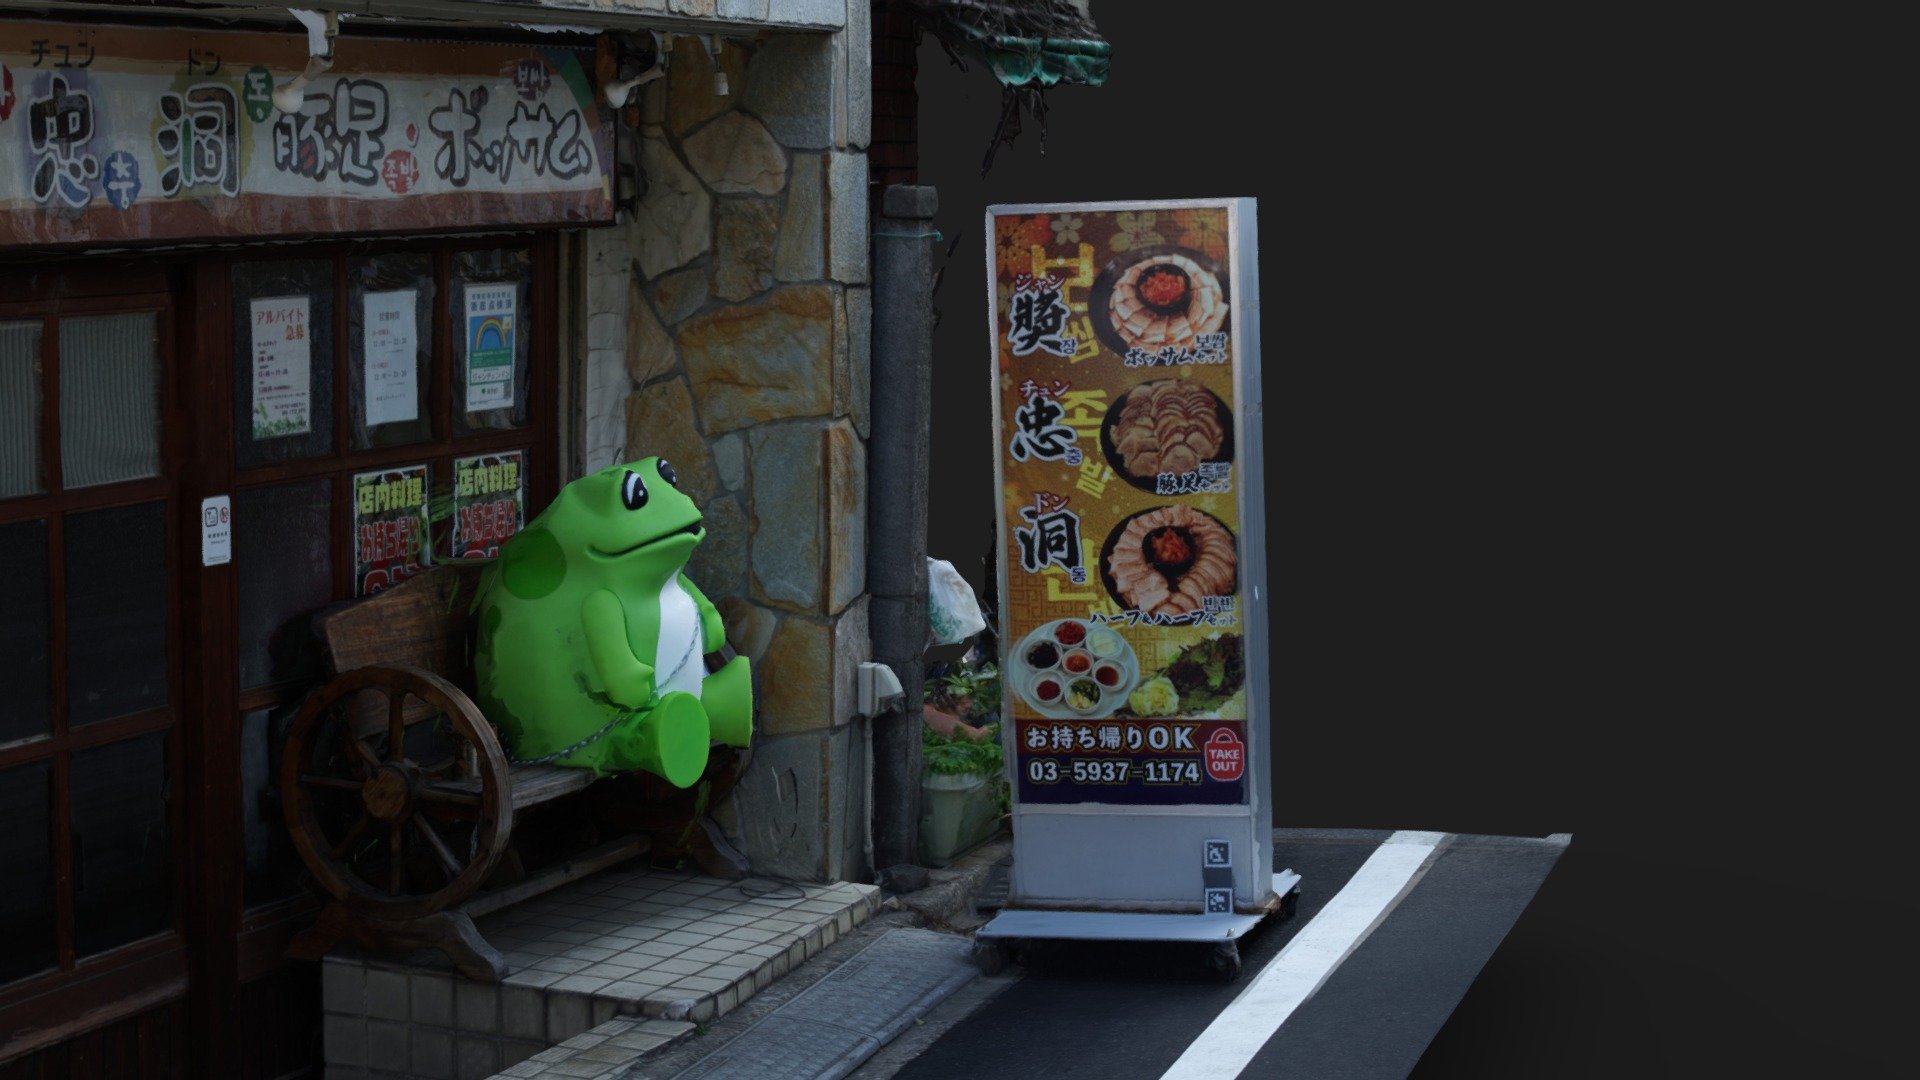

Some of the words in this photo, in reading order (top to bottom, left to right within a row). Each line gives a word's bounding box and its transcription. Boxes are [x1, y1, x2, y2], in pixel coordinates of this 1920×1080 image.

[30, 39, 95, 68] チュン
[188, 48, 221, 76] ドン
[1016, 273, 1066, 291] ジャン
[256, 308, 304, 324] アルバイト
[1020, 379, 1071, 399] チュン
[1010, 395, 1077, 461] 忠
[1034, 492, 1070, 514] ドン
[1015, 508, 1083, 573] 洞
[1027, 726, 1194, 750] お持ち帰りOK
[1210, 748, 1240, 760] TAKE
[1029, 761, 1199, 782] 03-5937-1174
[1212, 761, 1238, 773] OUT
